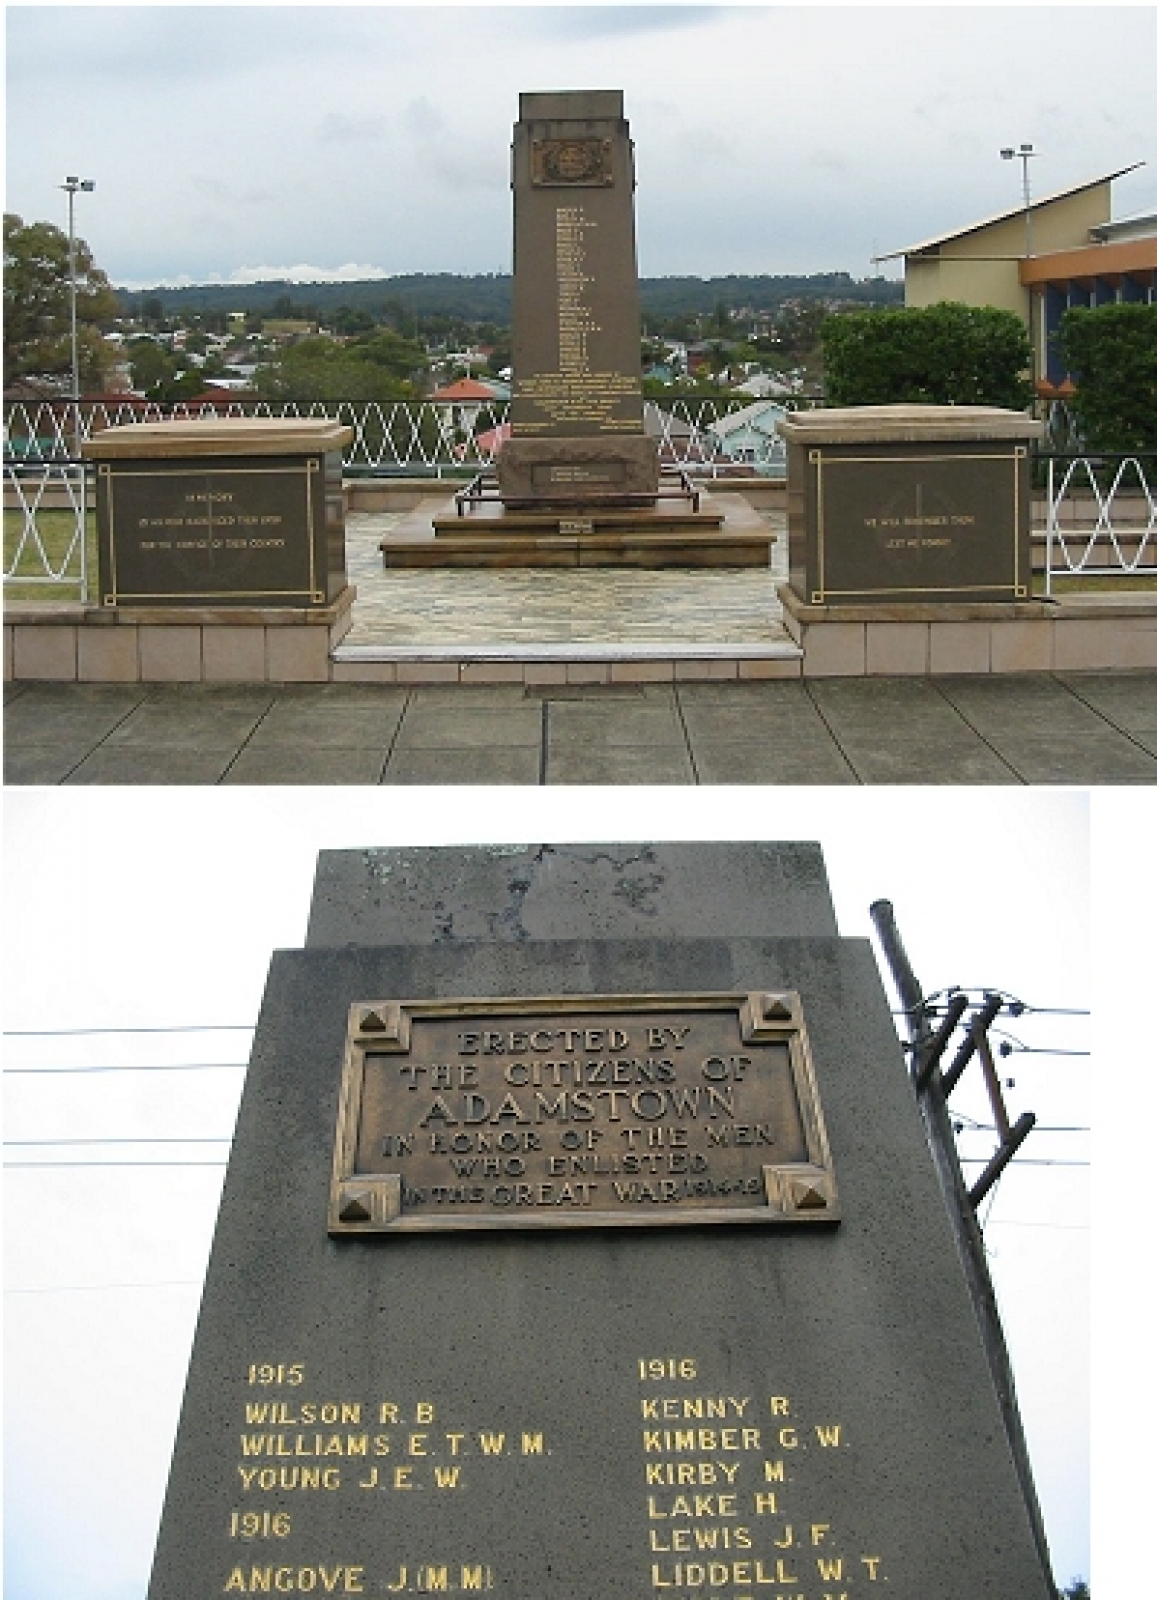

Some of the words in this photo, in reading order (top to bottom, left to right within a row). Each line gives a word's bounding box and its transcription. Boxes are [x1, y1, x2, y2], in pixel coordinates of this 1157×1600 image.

[458, 1028, 630, 1056] ERECTED
[646, 1026, 691, 1051] BY
[400, 1063, 480, 1091] THE
[504, 1057, 676, 1088] CITIZENS
[701, 1054, 752, 1082] OF
[418, 1086, 735, 1129] ADAMSTOWN
[383, 1132, 416, 1157] IN
[429, 1129, 543, 1155] HONOR
[560, 1128, 604, 1151] OF
[620, 1126, 688, 1150] THE
[704, 1123, 775, 1149] MEN
[450, 1155, 527, 1180] WHO
[548, 1150, 708, 1178] ENLISTED
[490, 1181, 600, 1207] GREAT
[611, 1179, 682, 1204] WAR
[249, 1362, 304, 1386] 1915
[638, 1358, 697, 1381] 1916
[245, 1402, 361, 1425] WILSON
[416, 1401, 435, 1425] B
[640, 1396, 751, 1418] KENNY
[240, 1433, 390, 1456] WILLIAMS
[642, 1427, 761, 1452] KIMBER
[237, 1466, 341, 1490] YOUNG
[645, 1460, 741, 1485] KIRBY
[647, 1495, 739, 1519] LAKE
[229, 1511, 291, 1537] 1916
[649, 1525, 753, 1552] LEWIS
[223, 1564, 364, 1592] ANGOVE
[650, 1558, 799, 1587] LIDDELL
